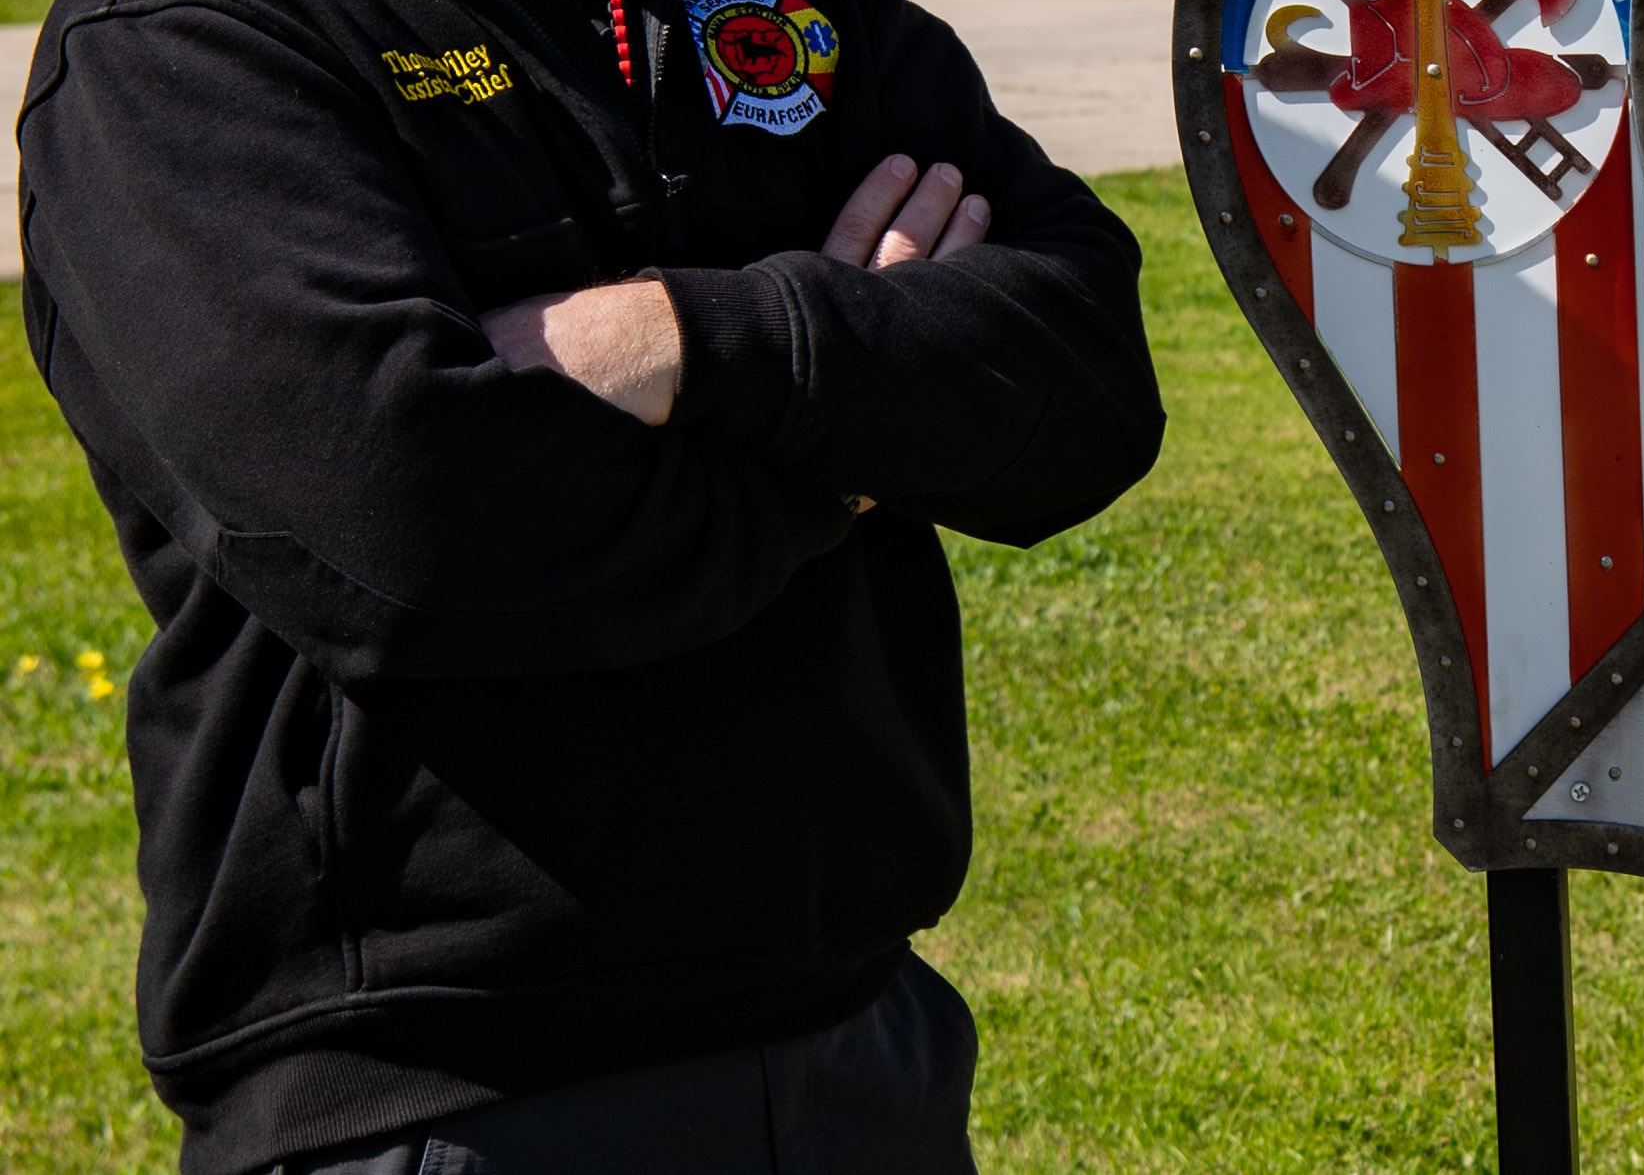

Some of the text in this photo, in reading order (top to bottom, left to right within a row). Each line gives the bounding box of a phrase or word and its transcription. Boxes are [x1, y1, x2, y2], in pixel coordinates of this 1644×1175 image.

[381, 49, 440, 73] Tho
[394, 63, 513, 104] ssista Chief
[732, 93, 819, 125] EURAFCENT
